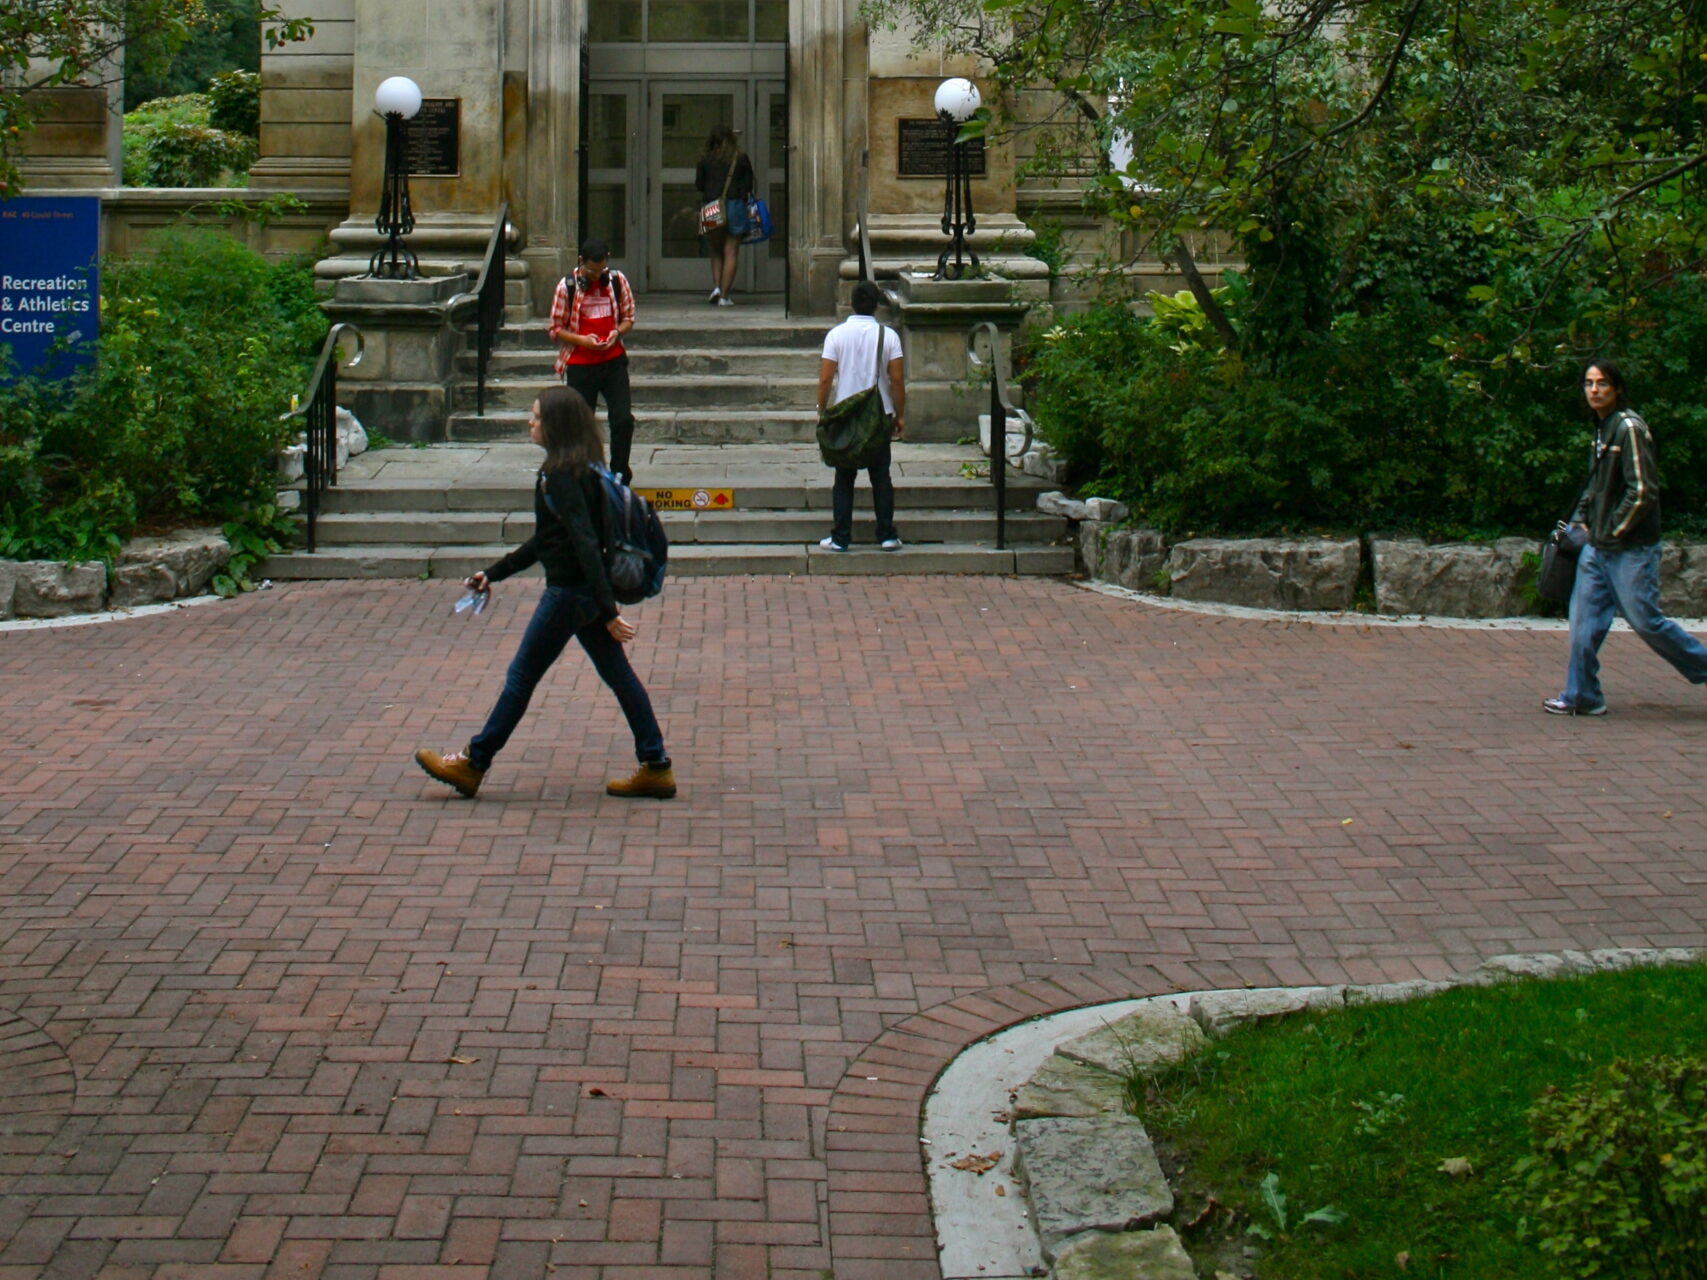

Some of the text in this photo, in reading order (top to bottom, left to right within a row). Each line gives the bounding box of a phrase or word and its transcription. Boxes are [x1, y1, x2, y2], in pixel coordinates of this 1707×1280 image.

[2, 275, 87, 290] Recreation
[1, 295, 89, 311] & Athletics
[1, 318, 55, 333] Centre
[656, 490, 673, 499] NO
